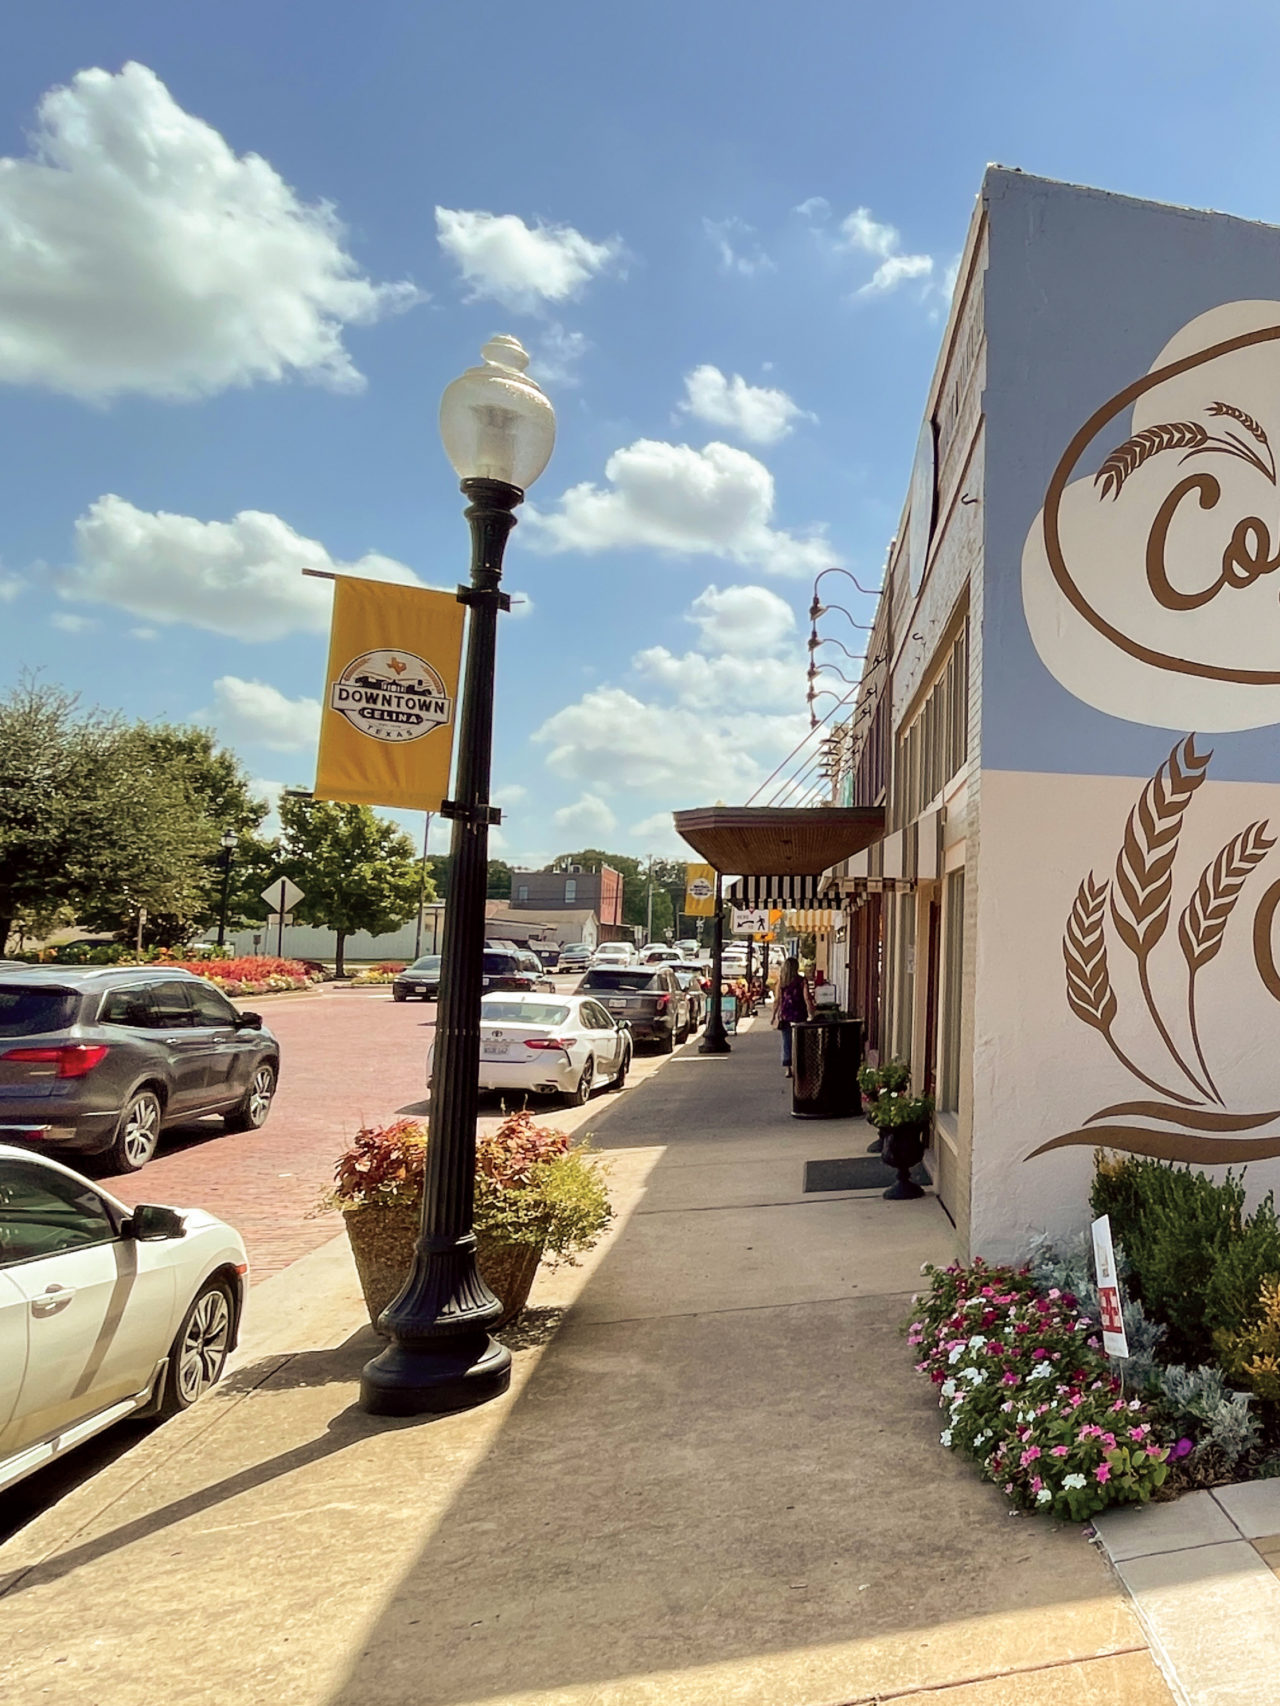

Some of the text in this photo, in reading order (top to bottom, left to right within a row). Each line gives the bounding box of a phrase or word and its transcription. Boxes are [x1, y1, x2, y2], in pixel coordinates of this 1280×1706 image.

[338, 687, 445, 715] DOWNTOWN
[363, 708, 418, 724] CELINA
[367, 724, 413, 738] TEXAS
